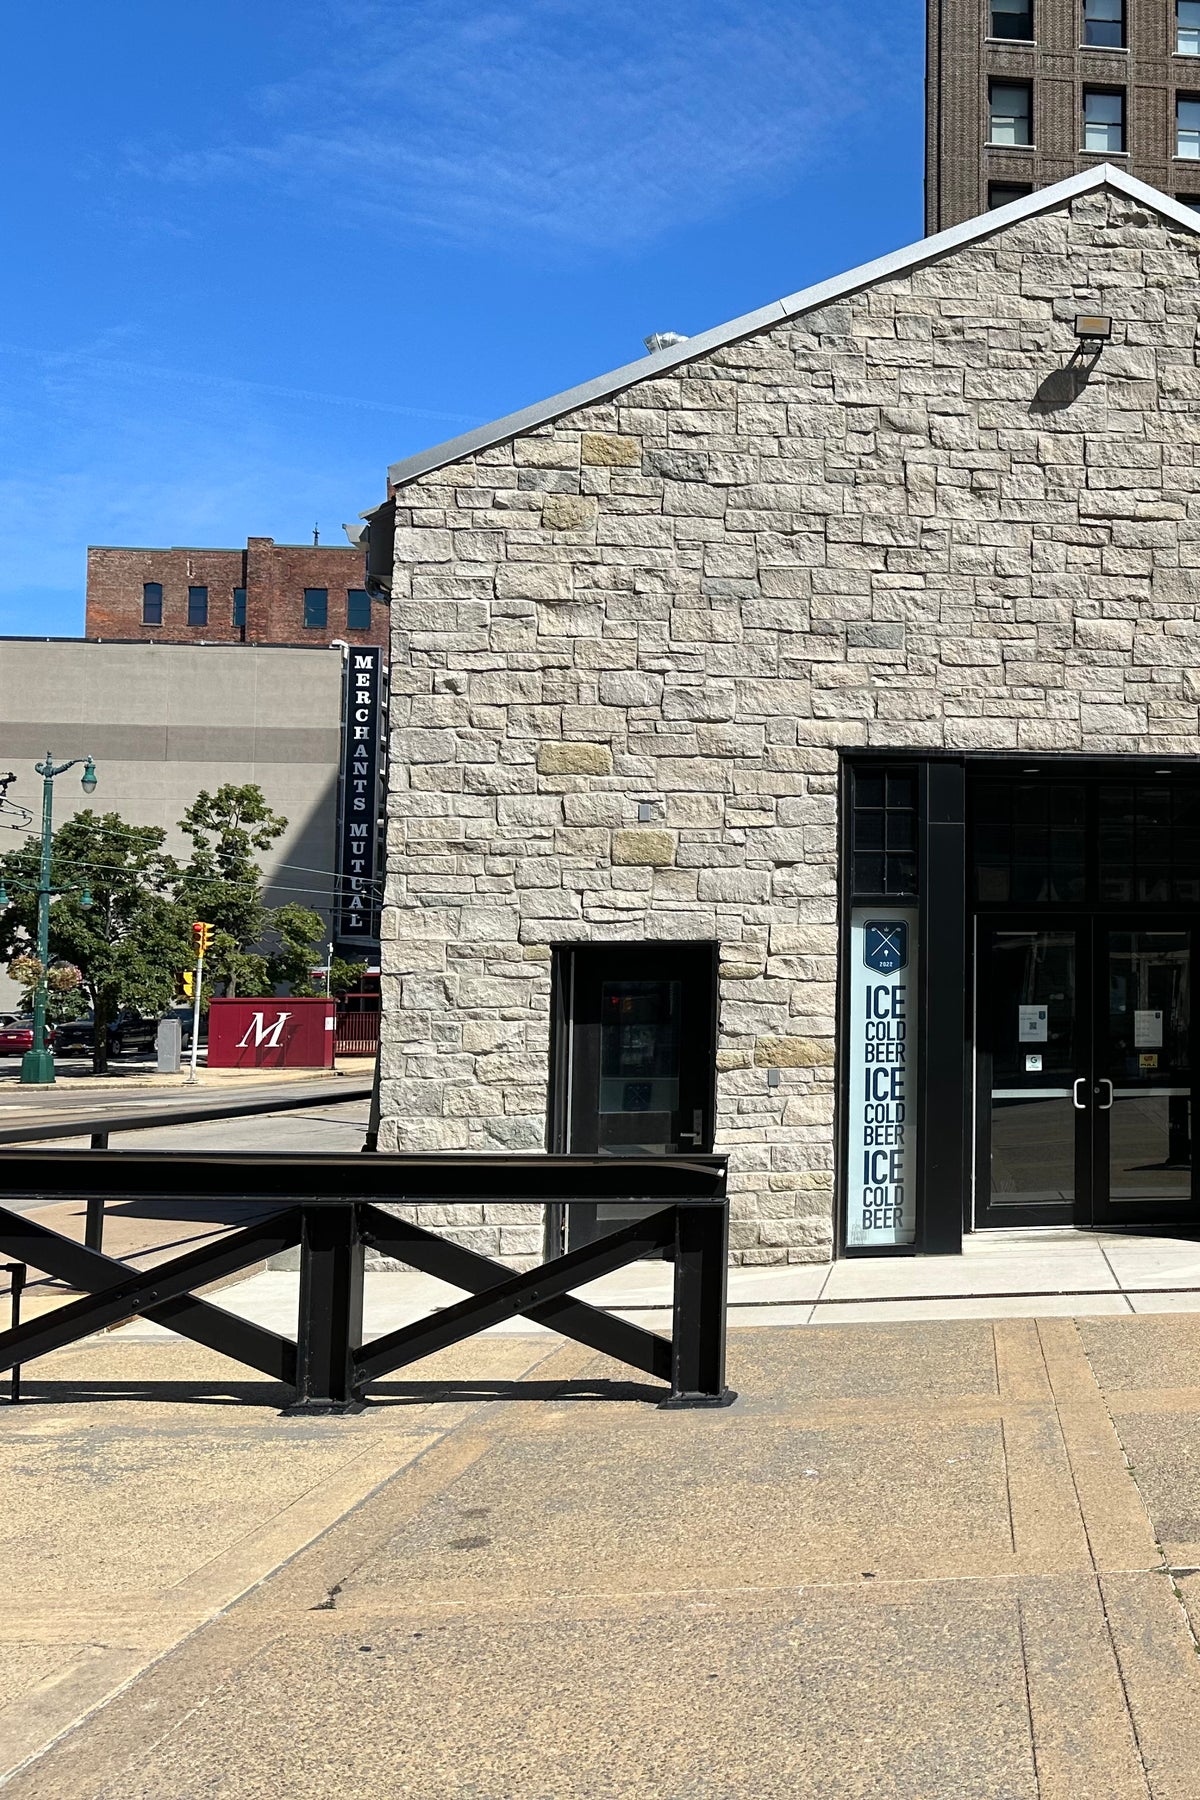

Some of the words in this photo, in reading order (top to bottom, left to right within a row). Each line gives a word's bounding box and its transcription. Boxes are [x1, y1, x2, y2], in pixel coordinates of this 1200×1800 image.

[353, 655, 374, 811] MERCHANTS
[348, 823, 368, 927] MUTUAL
[866, 985, 906, 1019] ICE
[865, 1020, 906, 1041] COLD
[865, 1042, 905, 1063] BEER
[865, 1067, 905, 1101] ICE
[864, 1103, 905, 1124] COLD
[864, 1125, 905, 1146] BEER
[864, 1149, 904, 1185] ICE
[863, 1185, 904, 1208] COLD
[863, 1207, 903, 1230] BEER
